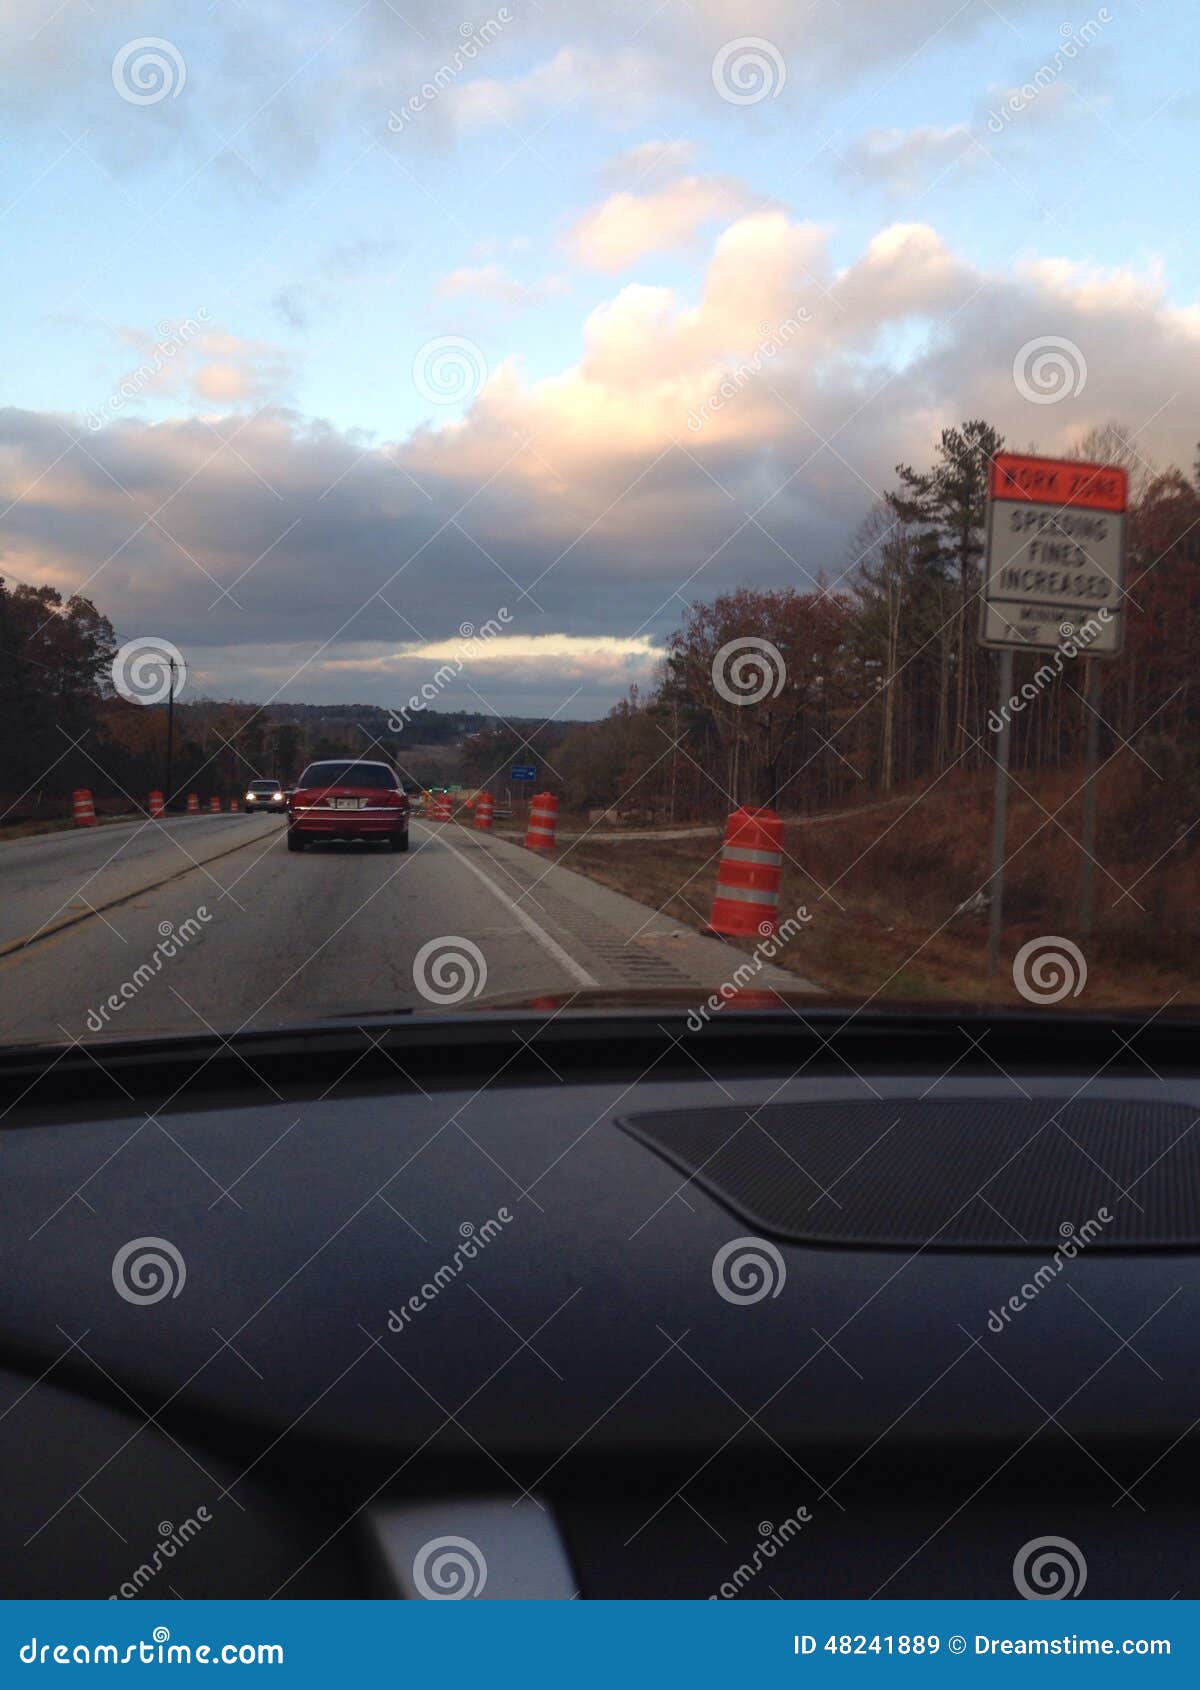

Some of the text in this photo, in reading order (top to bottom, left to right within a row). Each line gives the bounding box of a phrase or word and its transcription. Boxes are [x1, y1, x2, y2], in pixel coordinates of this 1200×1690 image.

[1001, 467, 1117, 499] WORK ZONE
[1010, 509, 1109, 542] SPEEDING
[1028, 540, 1087, 568] FINES
[1001, 567, 1111, 600] INCREASED
